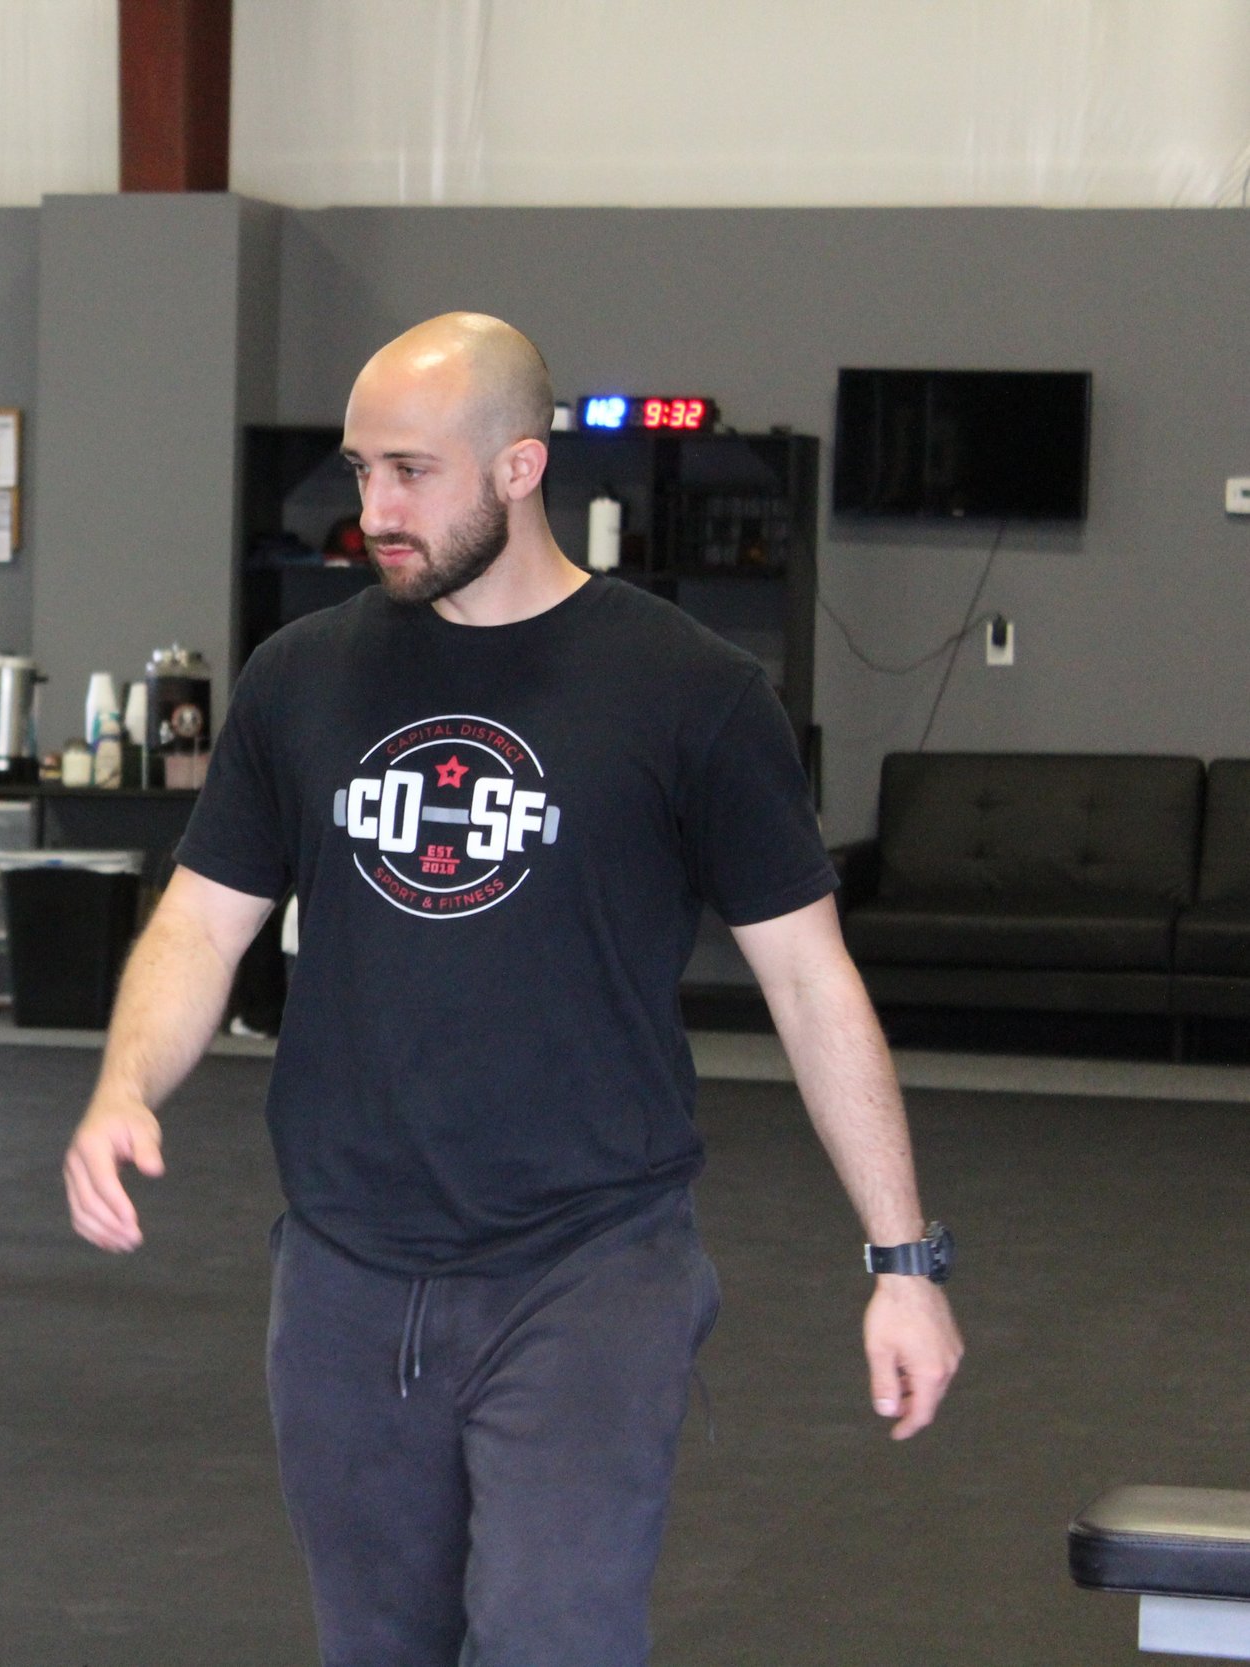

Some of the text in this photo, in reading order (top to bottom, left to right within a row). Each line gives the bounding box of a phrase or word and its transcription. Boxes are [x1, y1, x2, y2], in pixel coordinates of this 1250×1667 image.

[645, 400, 703, 429] 9:32
[386, 724, 525, 763] CAPITAL DISTRICT
[427, 845, 454, 858] EST
[422, 861, 456, 875] 2018
[373, 867, 505, 910] SPORT & FITNESS
